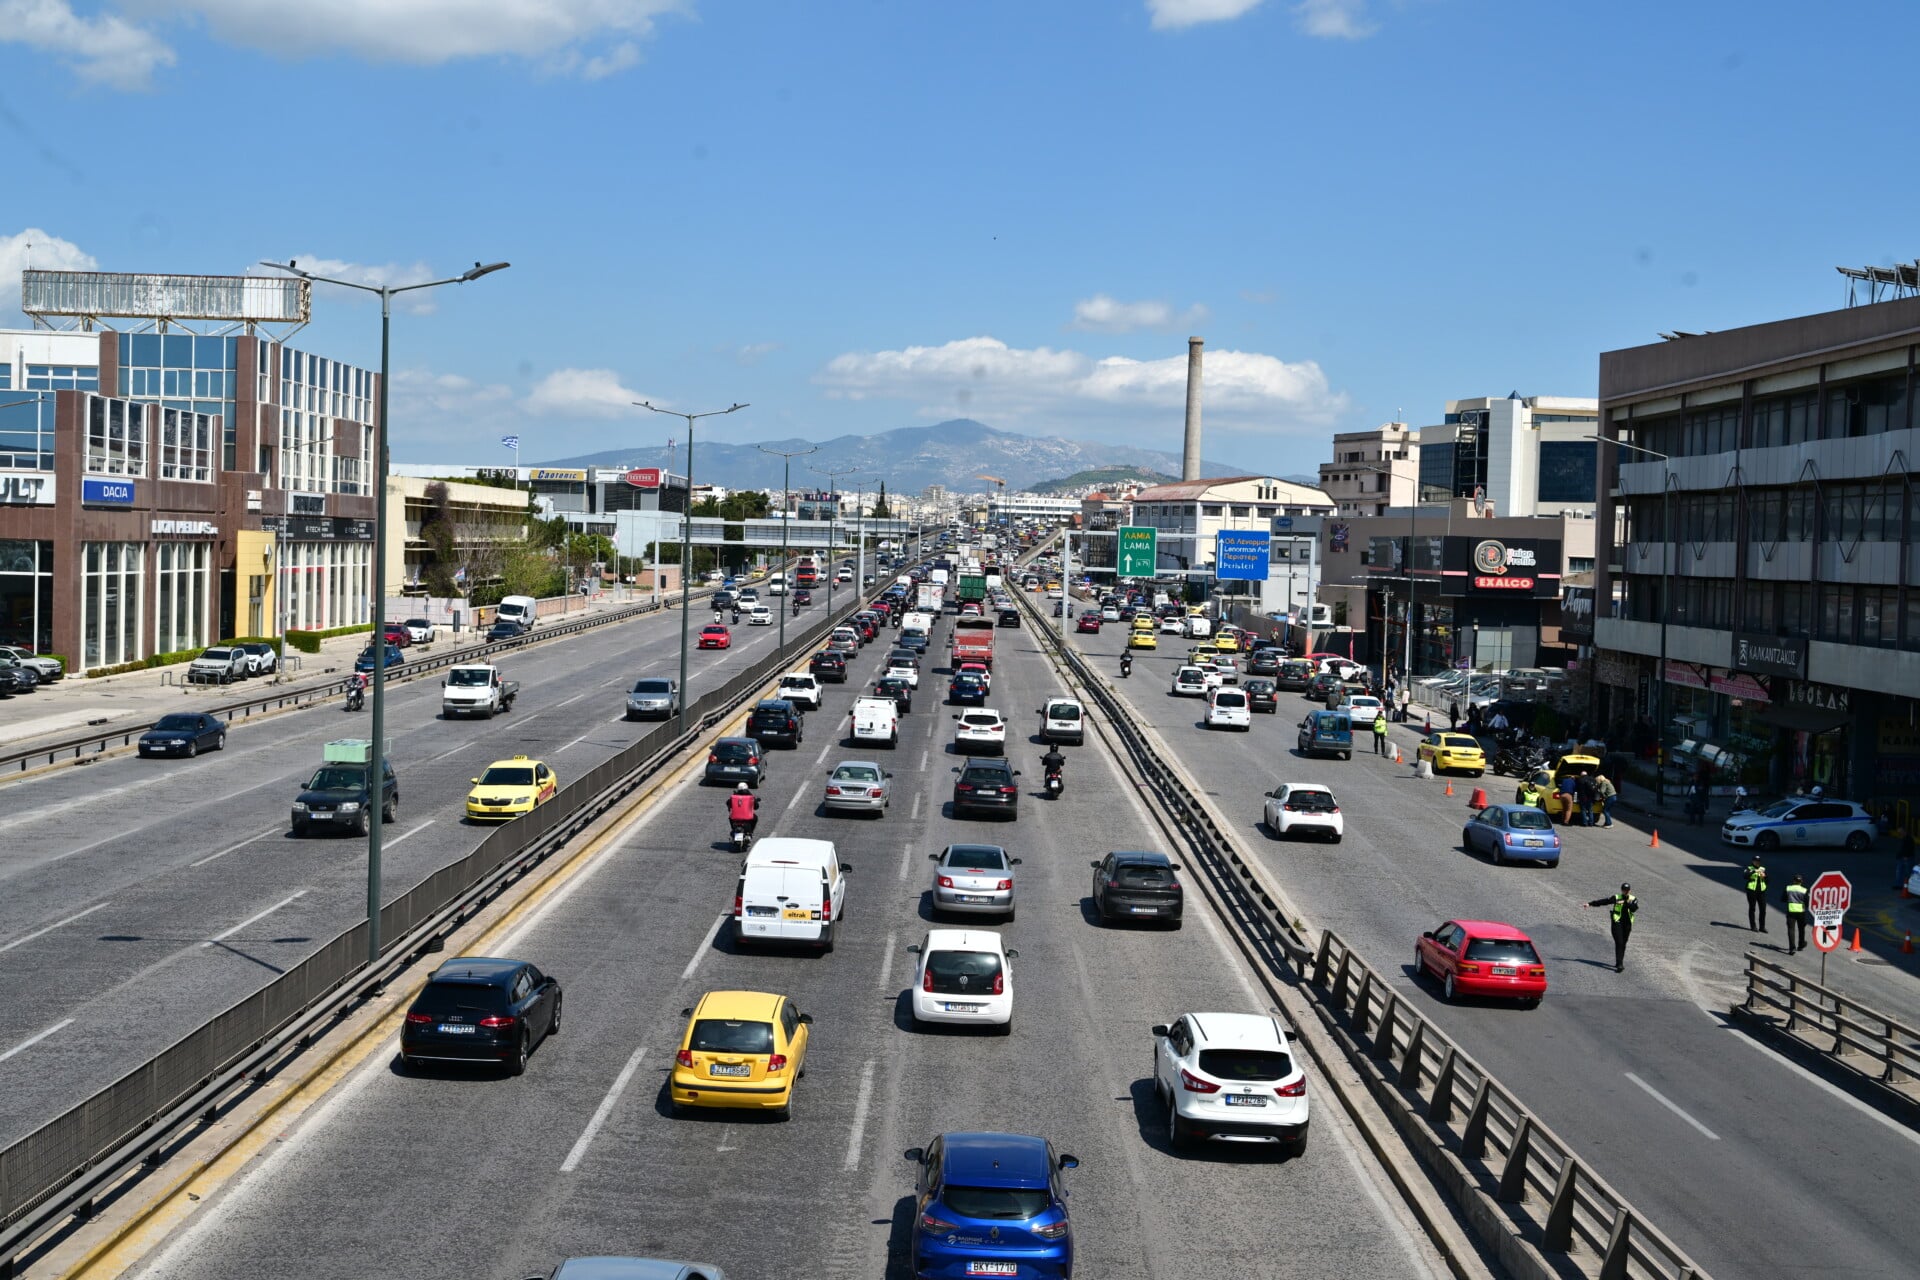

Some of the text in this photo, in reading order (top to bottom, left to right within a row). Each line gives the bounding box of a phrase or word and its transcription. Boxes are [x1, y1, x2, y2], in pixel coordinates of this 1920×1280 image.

[103, 485, 128, 498] DACIA
[1124, 532, 1151, 540] ΛΑΜΙΑ
[1124, 542, 1150, 550] LAMIA
[1506, 548, 1534, 558] Union
[1506, 557, 1536, 566] Profile
[1479, 577, 1530, 588] EXALCO
[1812, 886, 1848, 911] STOP
